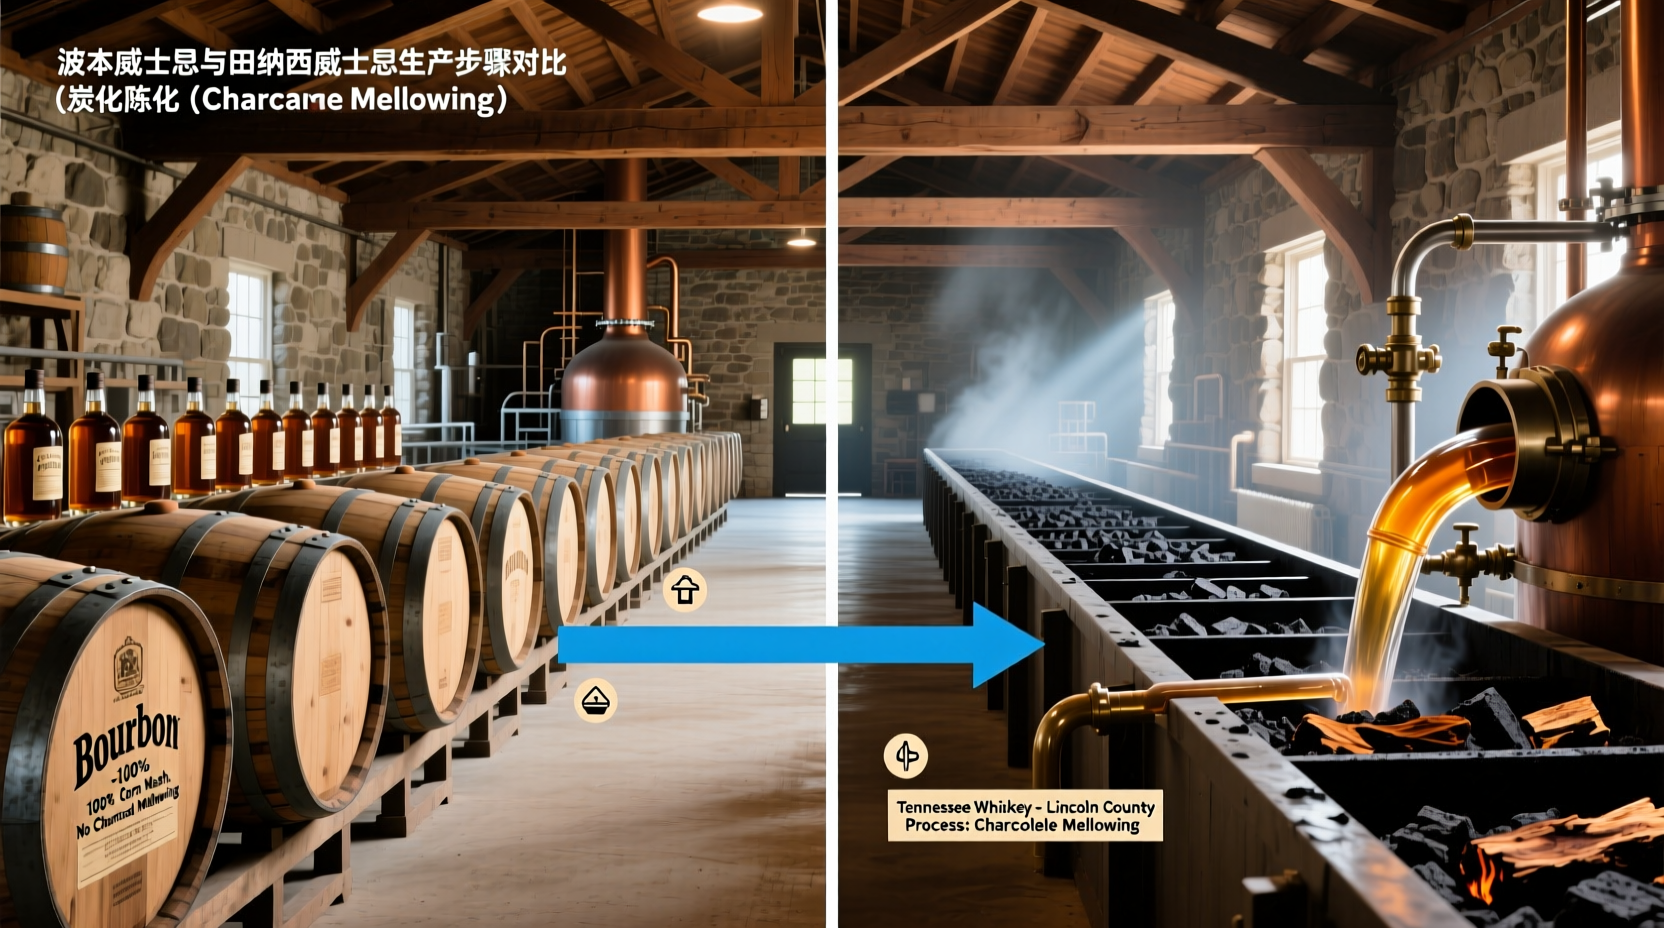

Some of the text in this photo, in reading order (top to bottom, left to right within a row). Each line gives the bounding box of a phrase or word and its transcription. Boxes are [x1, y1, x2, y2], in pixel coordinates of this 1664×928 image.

[73, 702, 180, 792] Bourbon
[86, 792, 115, 816] 100%
[76, 822, 91, 840] No
